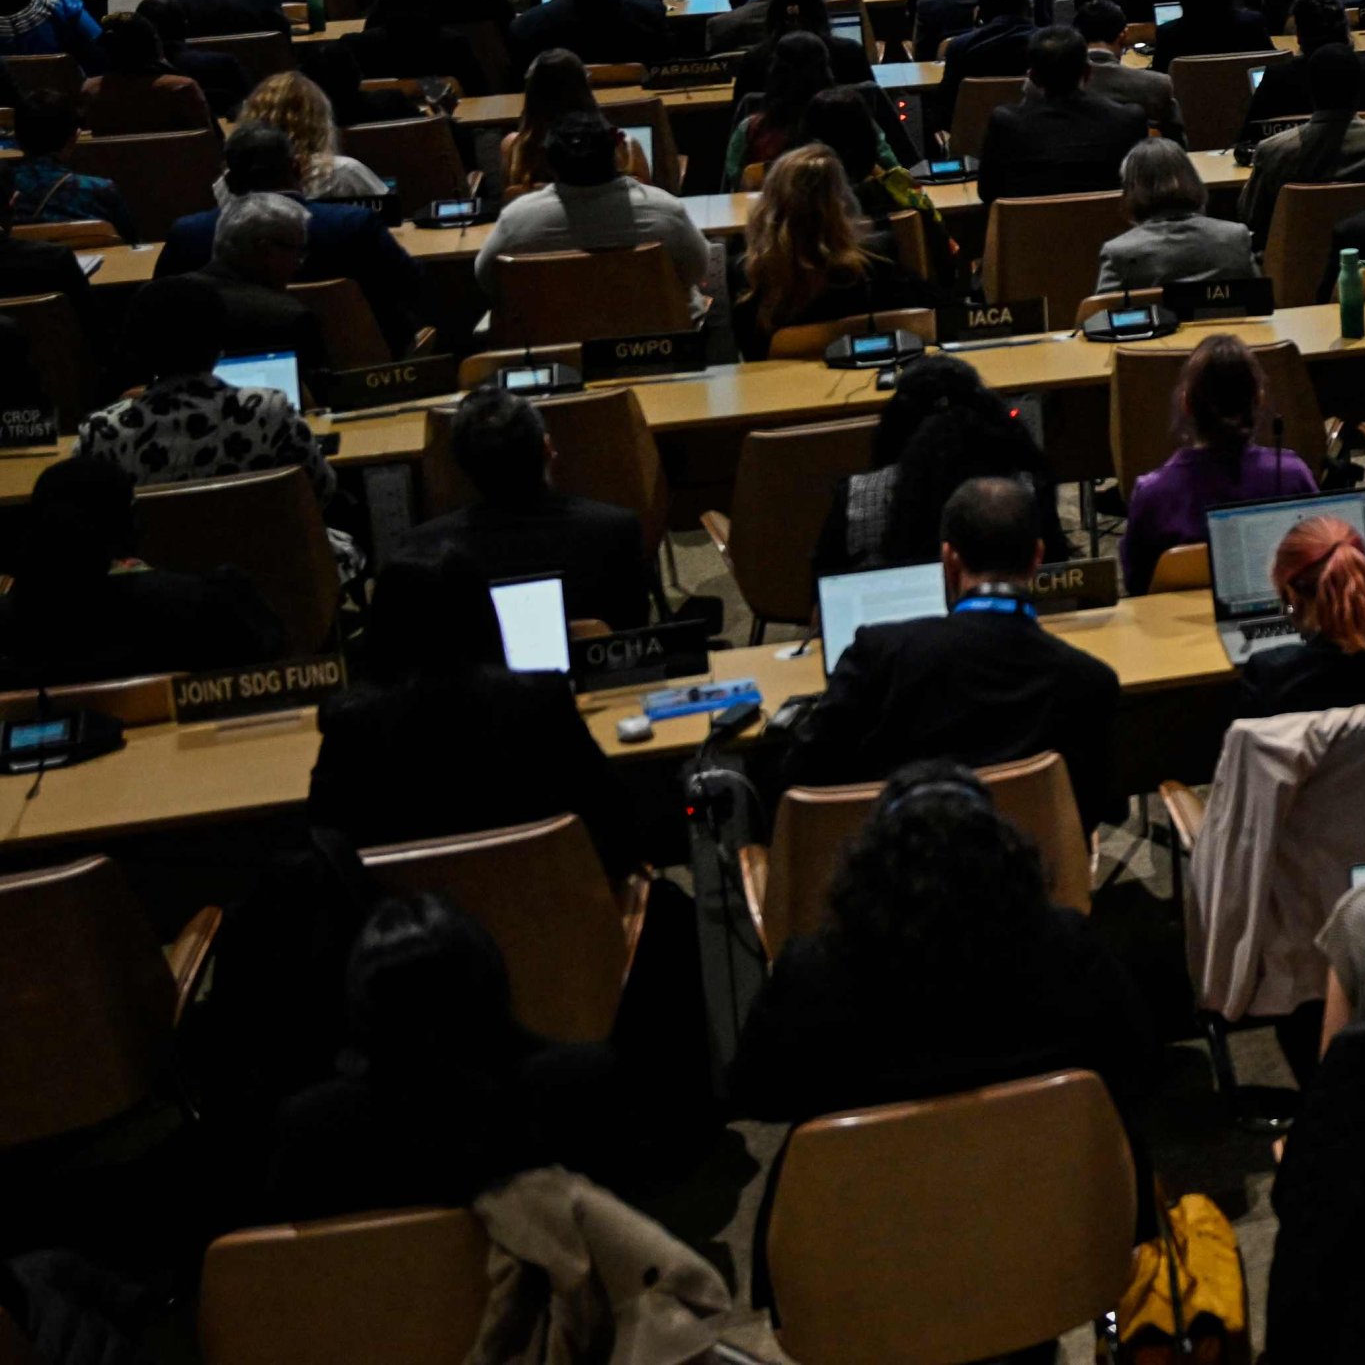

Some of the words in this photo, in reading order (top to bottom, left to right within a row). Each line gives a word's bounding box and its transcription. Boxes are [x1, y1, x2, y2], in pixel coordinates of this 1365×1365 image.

[650, 62, 729, 77] PARAGUAY
[1206, 284, 1231, 300] IAI
[967, 306, 1014, 329] IACA
[2, 409, 42, 426] CROP
[9, 422, 54, 439] TRUST
[587, 636, 665, 666] OCHA
[178, 679, 233, 706] JOINT
[239, 674, 281, 698] SDG
[286, 670, 340, 693] FUND
